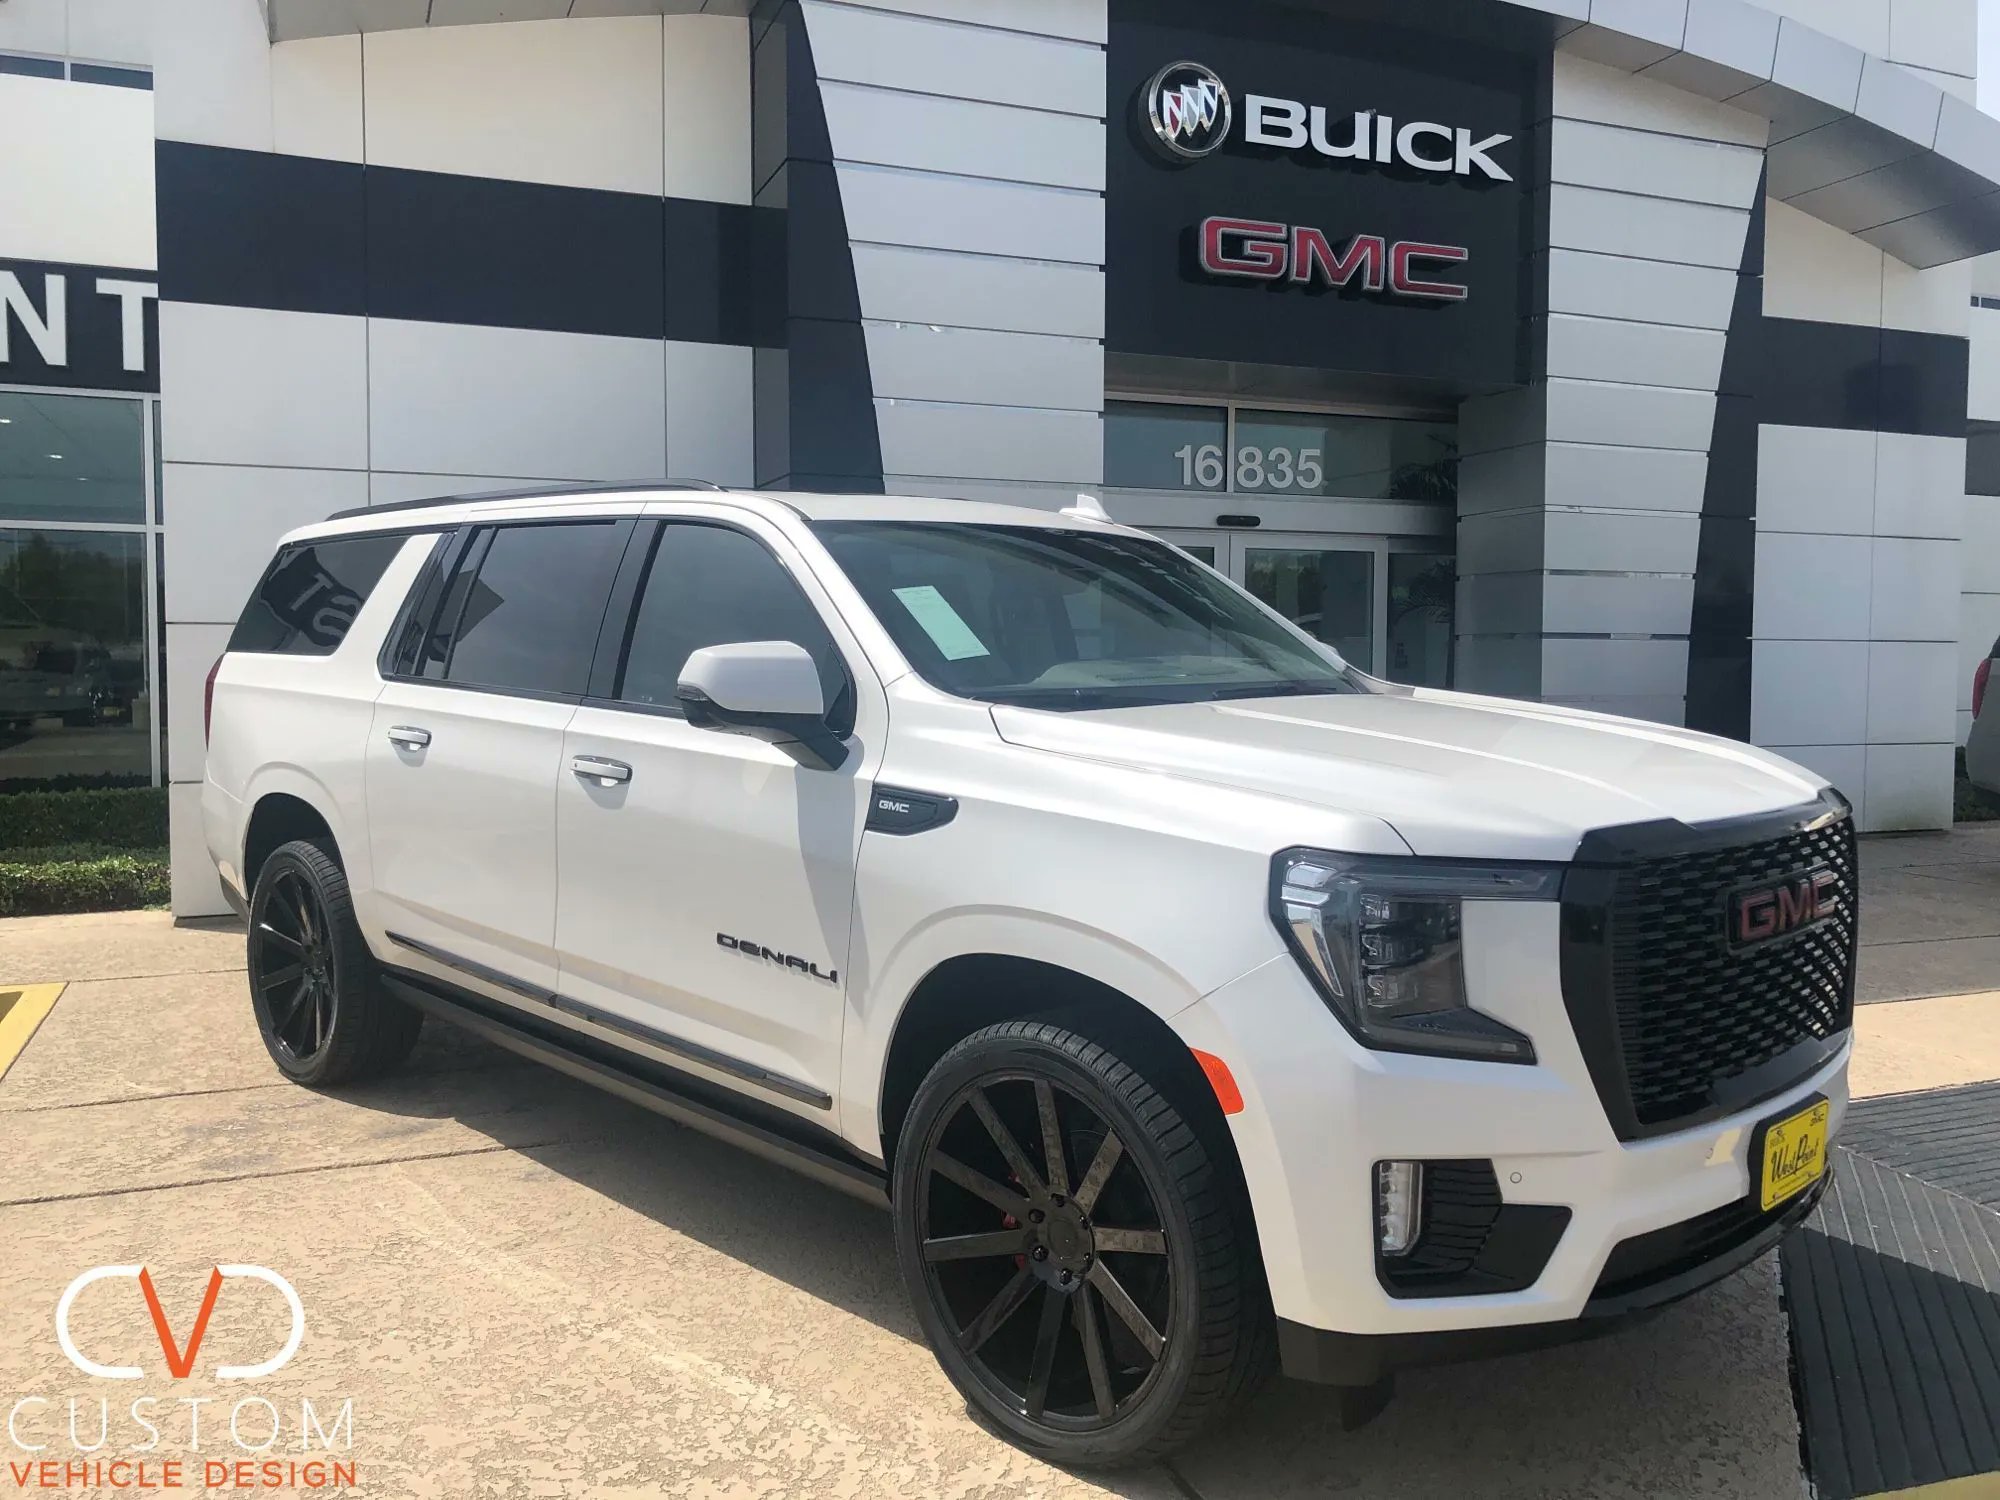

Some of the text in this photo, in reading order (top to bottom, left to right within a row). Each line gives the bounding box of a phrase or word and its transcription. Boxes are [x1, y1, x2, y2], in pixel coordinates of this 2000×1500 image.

[1245, 94, 1513, 181] BUICK
[1201, 216, 1468, 299] GMC
[879, 800, 909, 813] GMC
[1742, 870, 1836, 939] GMC
[717, 932, 837, 983] DENALI
